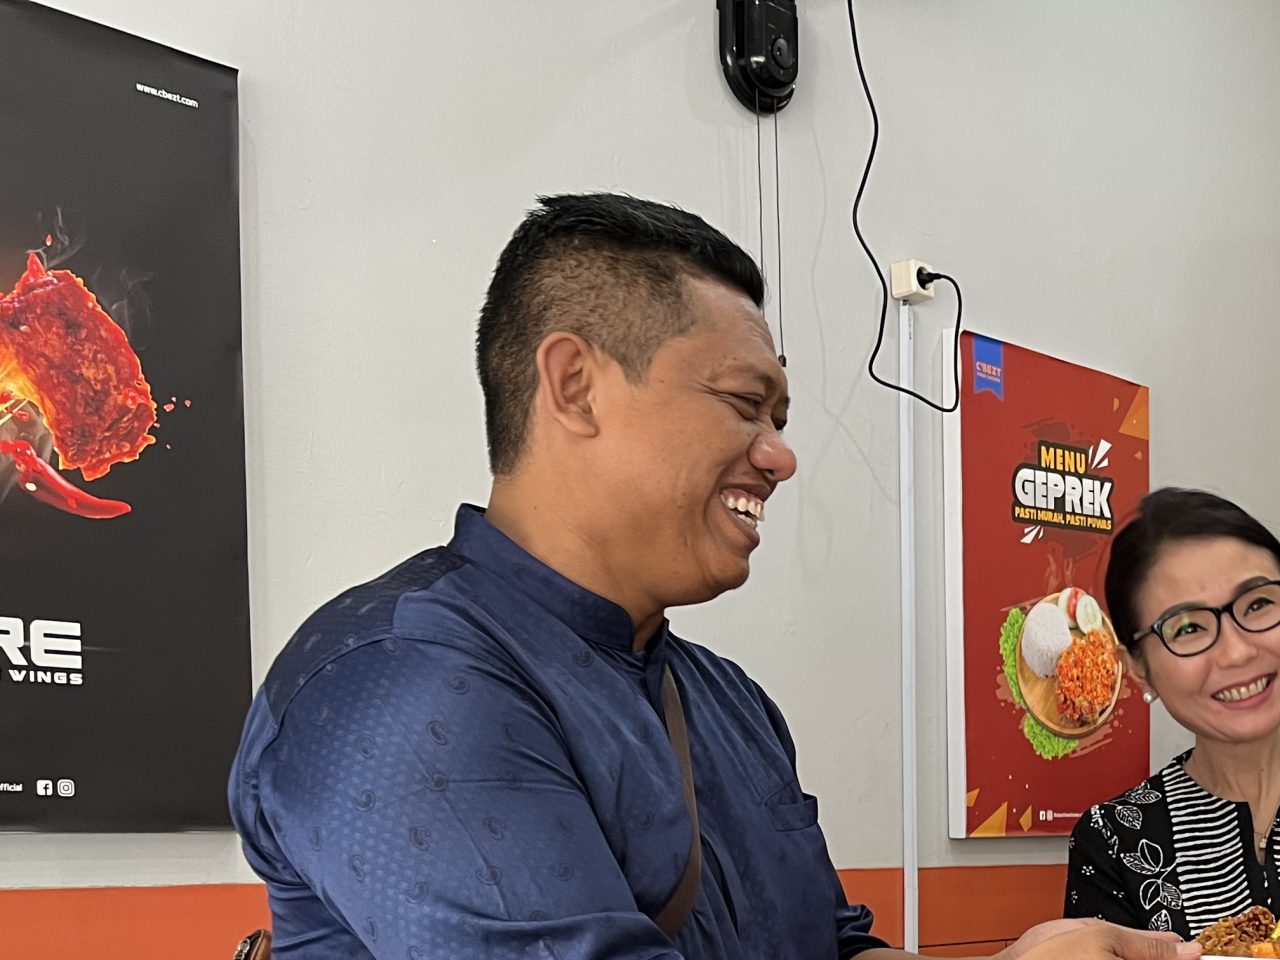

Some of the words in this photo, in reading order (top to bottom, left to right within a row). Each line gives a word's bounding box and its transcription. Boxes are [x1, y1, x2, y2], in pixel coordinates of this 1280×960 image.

[136, 83, 199, 108] www.cbezt.com
[1041, 445, 1086, 474] MENU
[1015, 468, 1113, 519] GEPREK
[1015, 506, 1036, 520] PASTI
[1066, 514, 1086, 527] PASTI
[8, 669, 84, 685] WINGS
